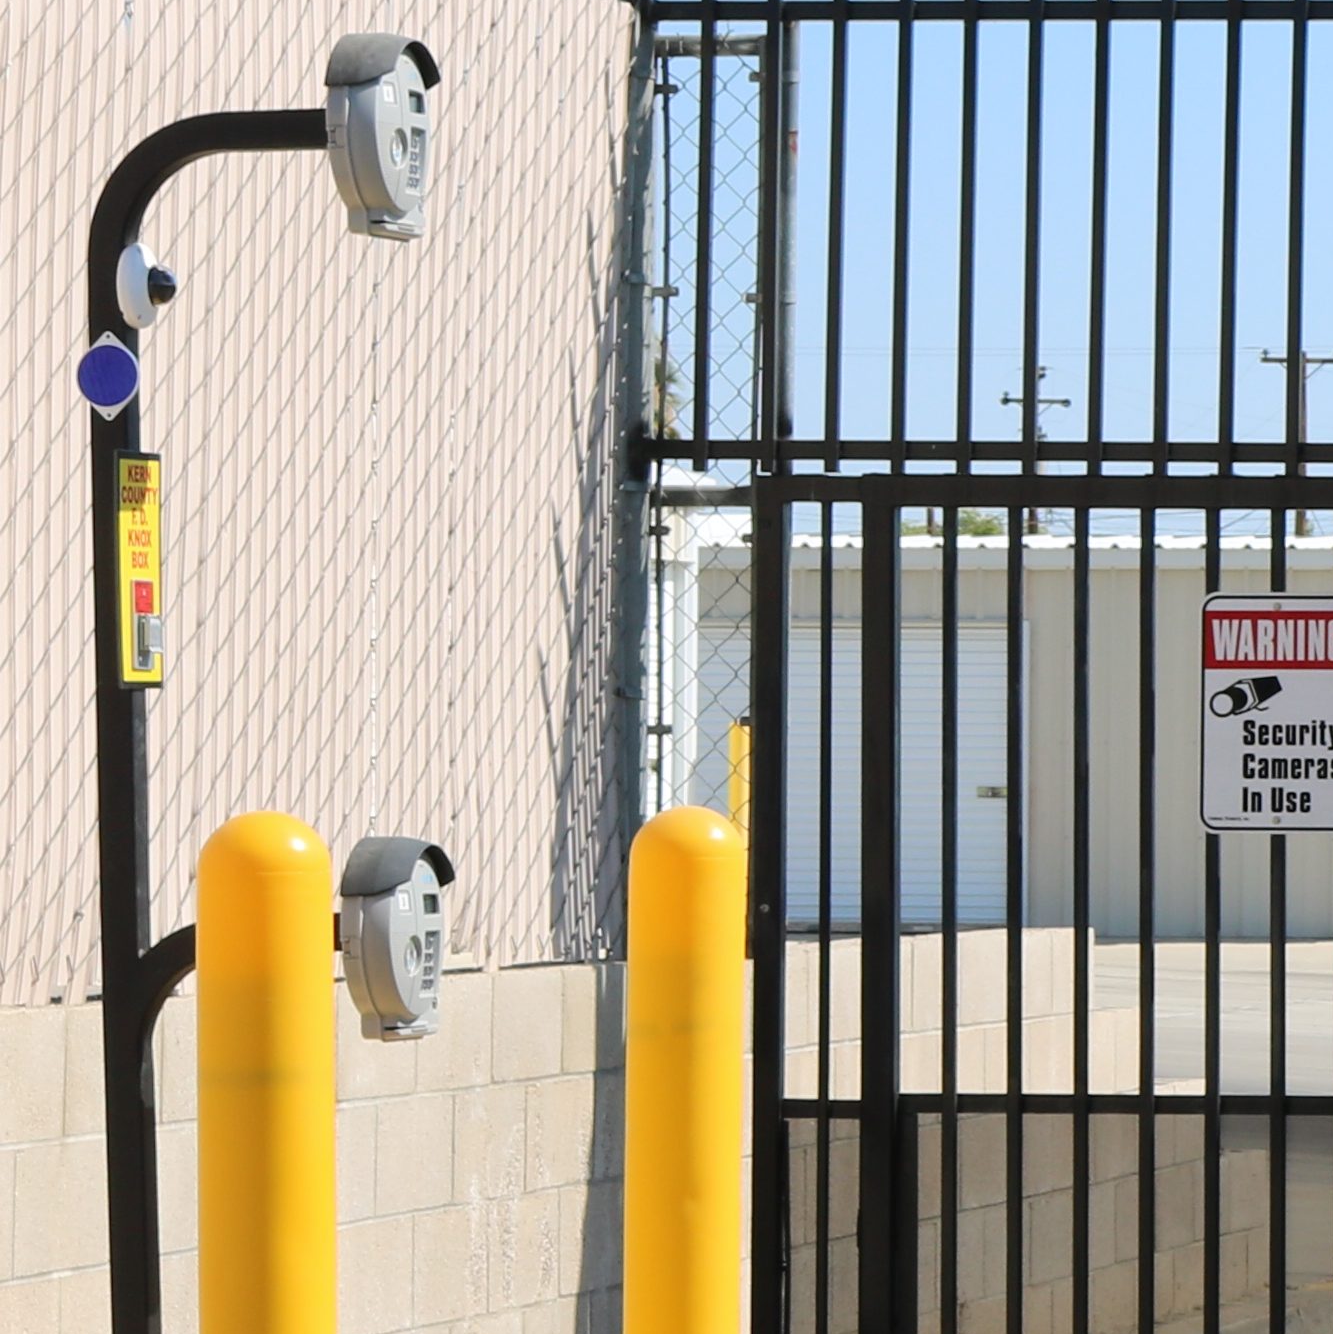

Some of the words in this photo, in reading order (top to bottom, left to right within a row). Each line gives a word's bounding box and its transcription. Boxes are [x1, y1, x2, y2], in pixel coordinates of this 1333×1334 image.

[127, 464, 152, 484] KERN
[121, 485, 159, 505] COUNTY
[127, 528, 153, 547] KNOX
[131, 550, 150, 569] BOX
[1241, 786, 1262, 813] In
[1270, 786, 1312, 813] Use
